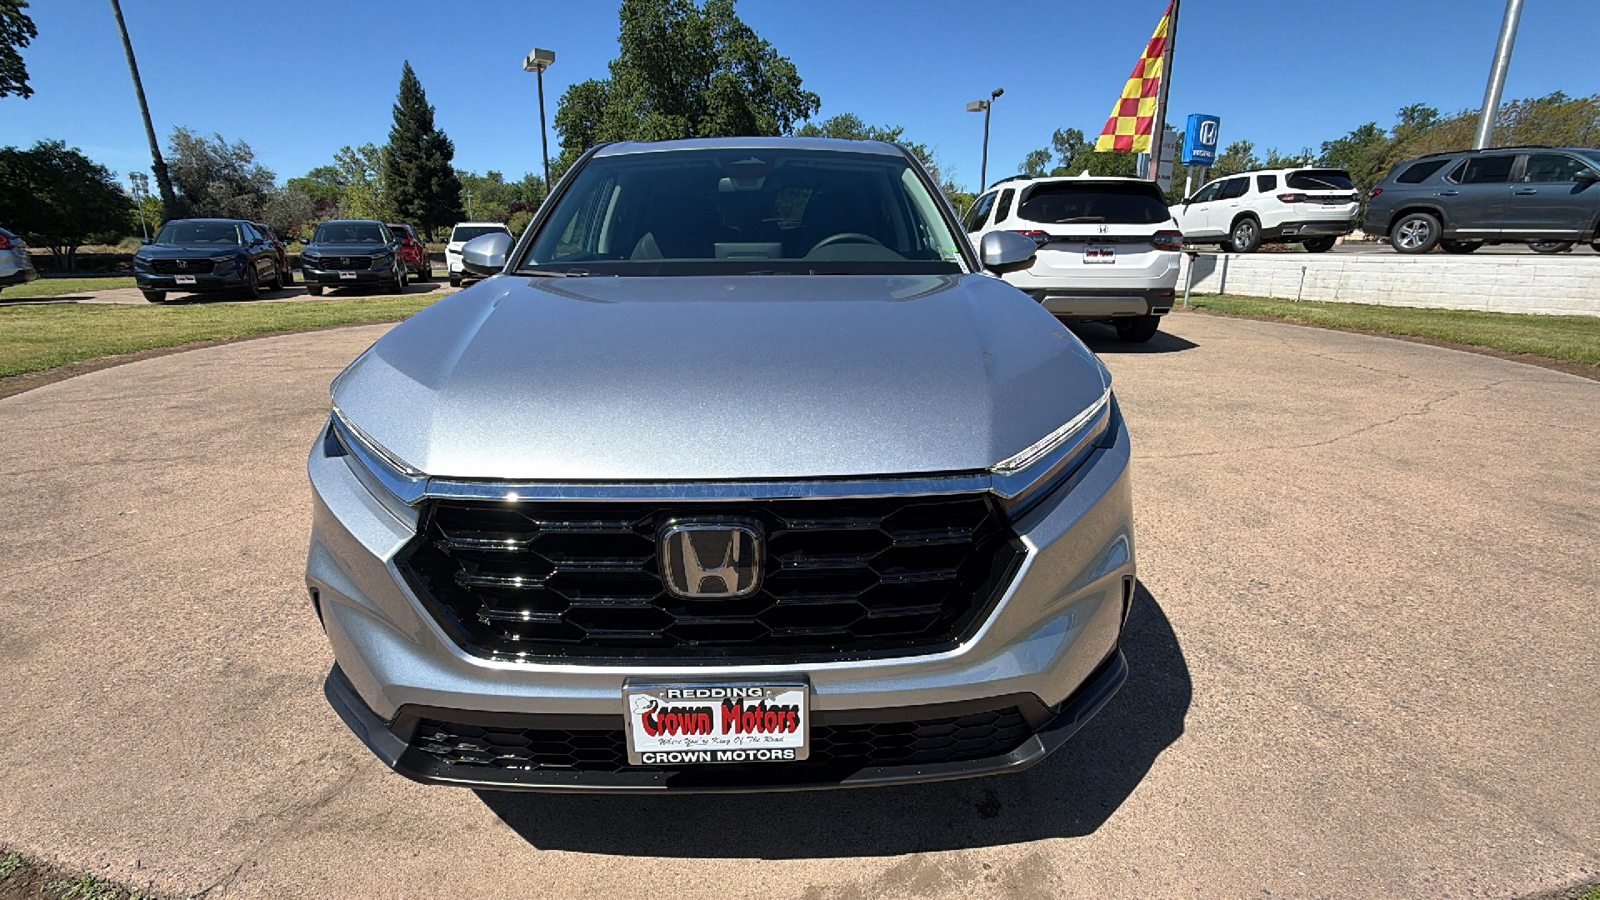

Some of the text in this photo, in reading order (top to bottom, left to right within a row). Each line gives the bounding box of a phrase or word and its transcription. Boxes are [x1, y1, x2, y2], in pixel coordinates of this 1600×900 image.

[667, 688, 763, 699] REDDING
[641, 698, 800, 737] Crown Motors
[658, 737, 682, 746] Where
[684, 737, 709, 747] You're
[711, 736, 731, 746] King
[733, 736, 744, 745] Of
[763, 735, 785, 743] Road
[642, 749, 795, 764] CROWN MOTORS
